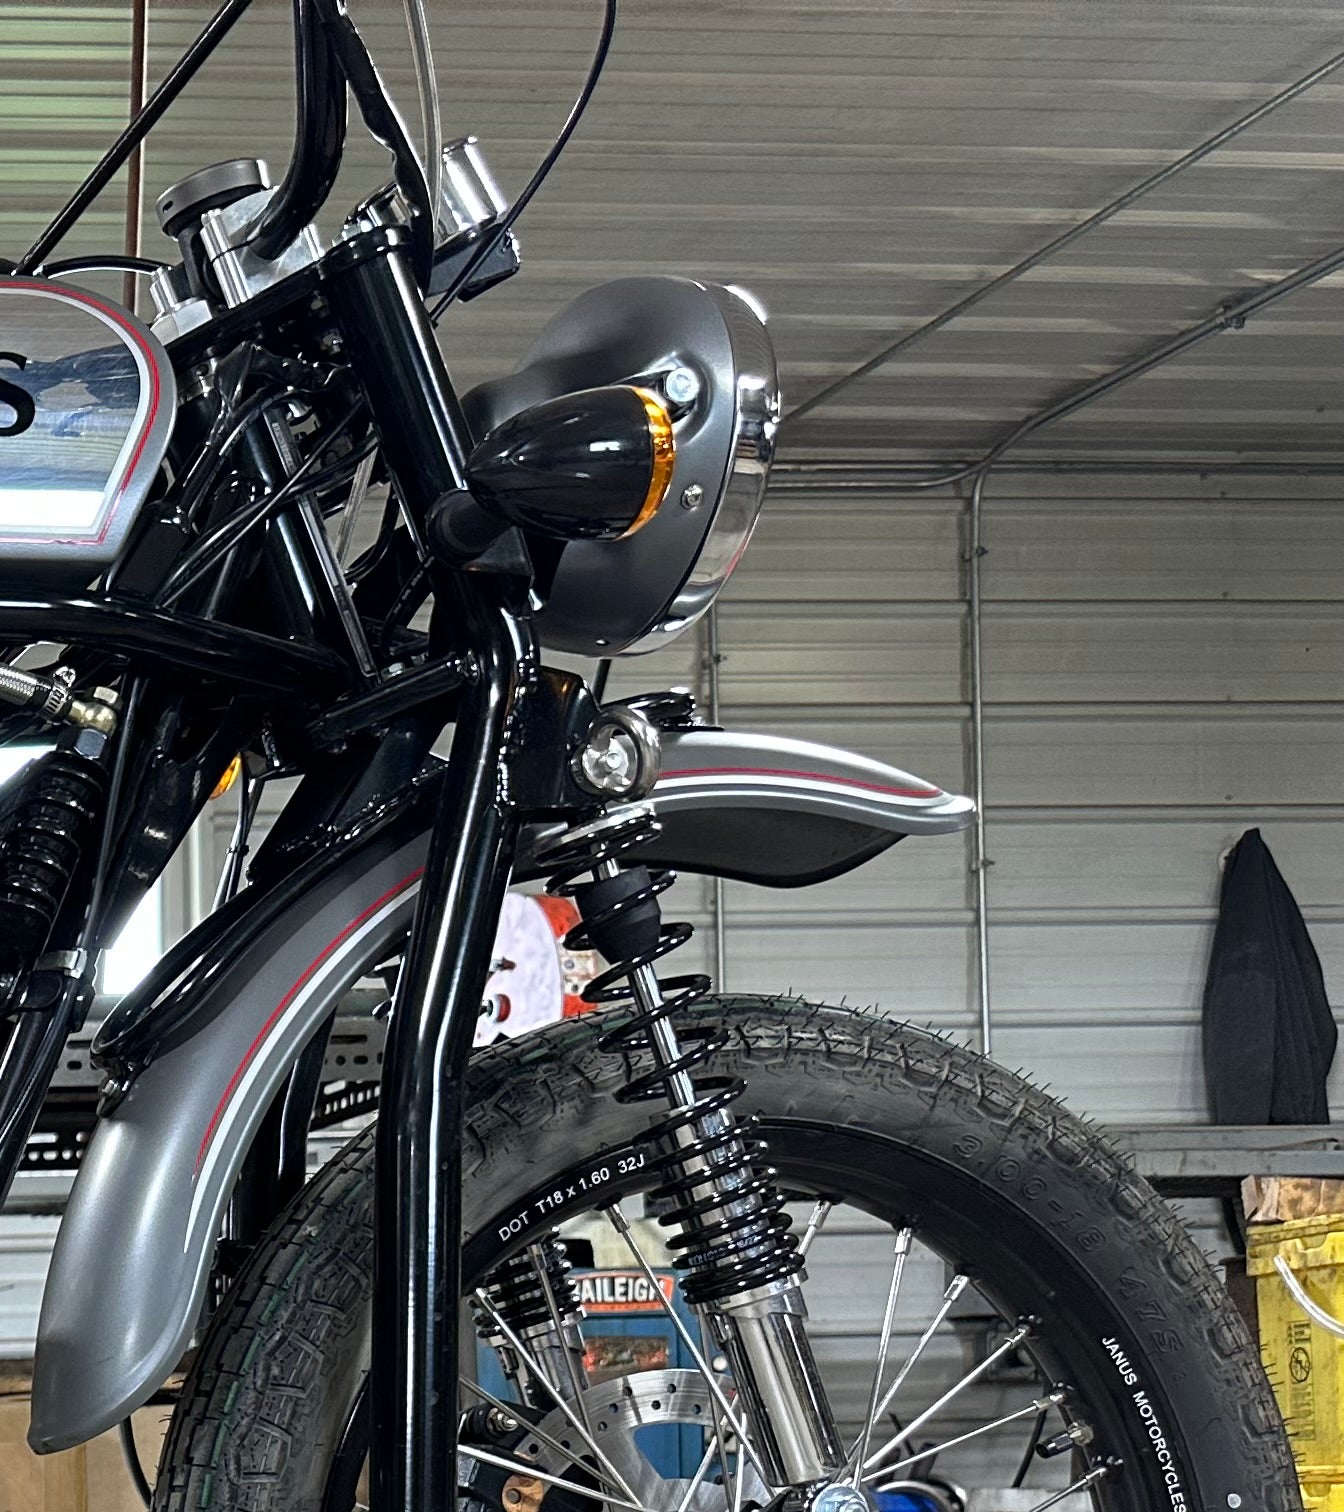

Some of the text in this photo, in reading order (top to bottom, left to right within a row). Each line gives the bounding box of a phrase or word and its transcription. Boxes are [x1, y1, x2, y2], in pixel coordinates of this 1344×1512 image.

[498, 1219, 530, 1242] DOT
[534, 1190, 563, 1215] T18
[578, 1167, 611, 1191] 1.60
[617, 1153, 646, 1174] 32J
[1101, 1336, 1138, 1386] JANUS
